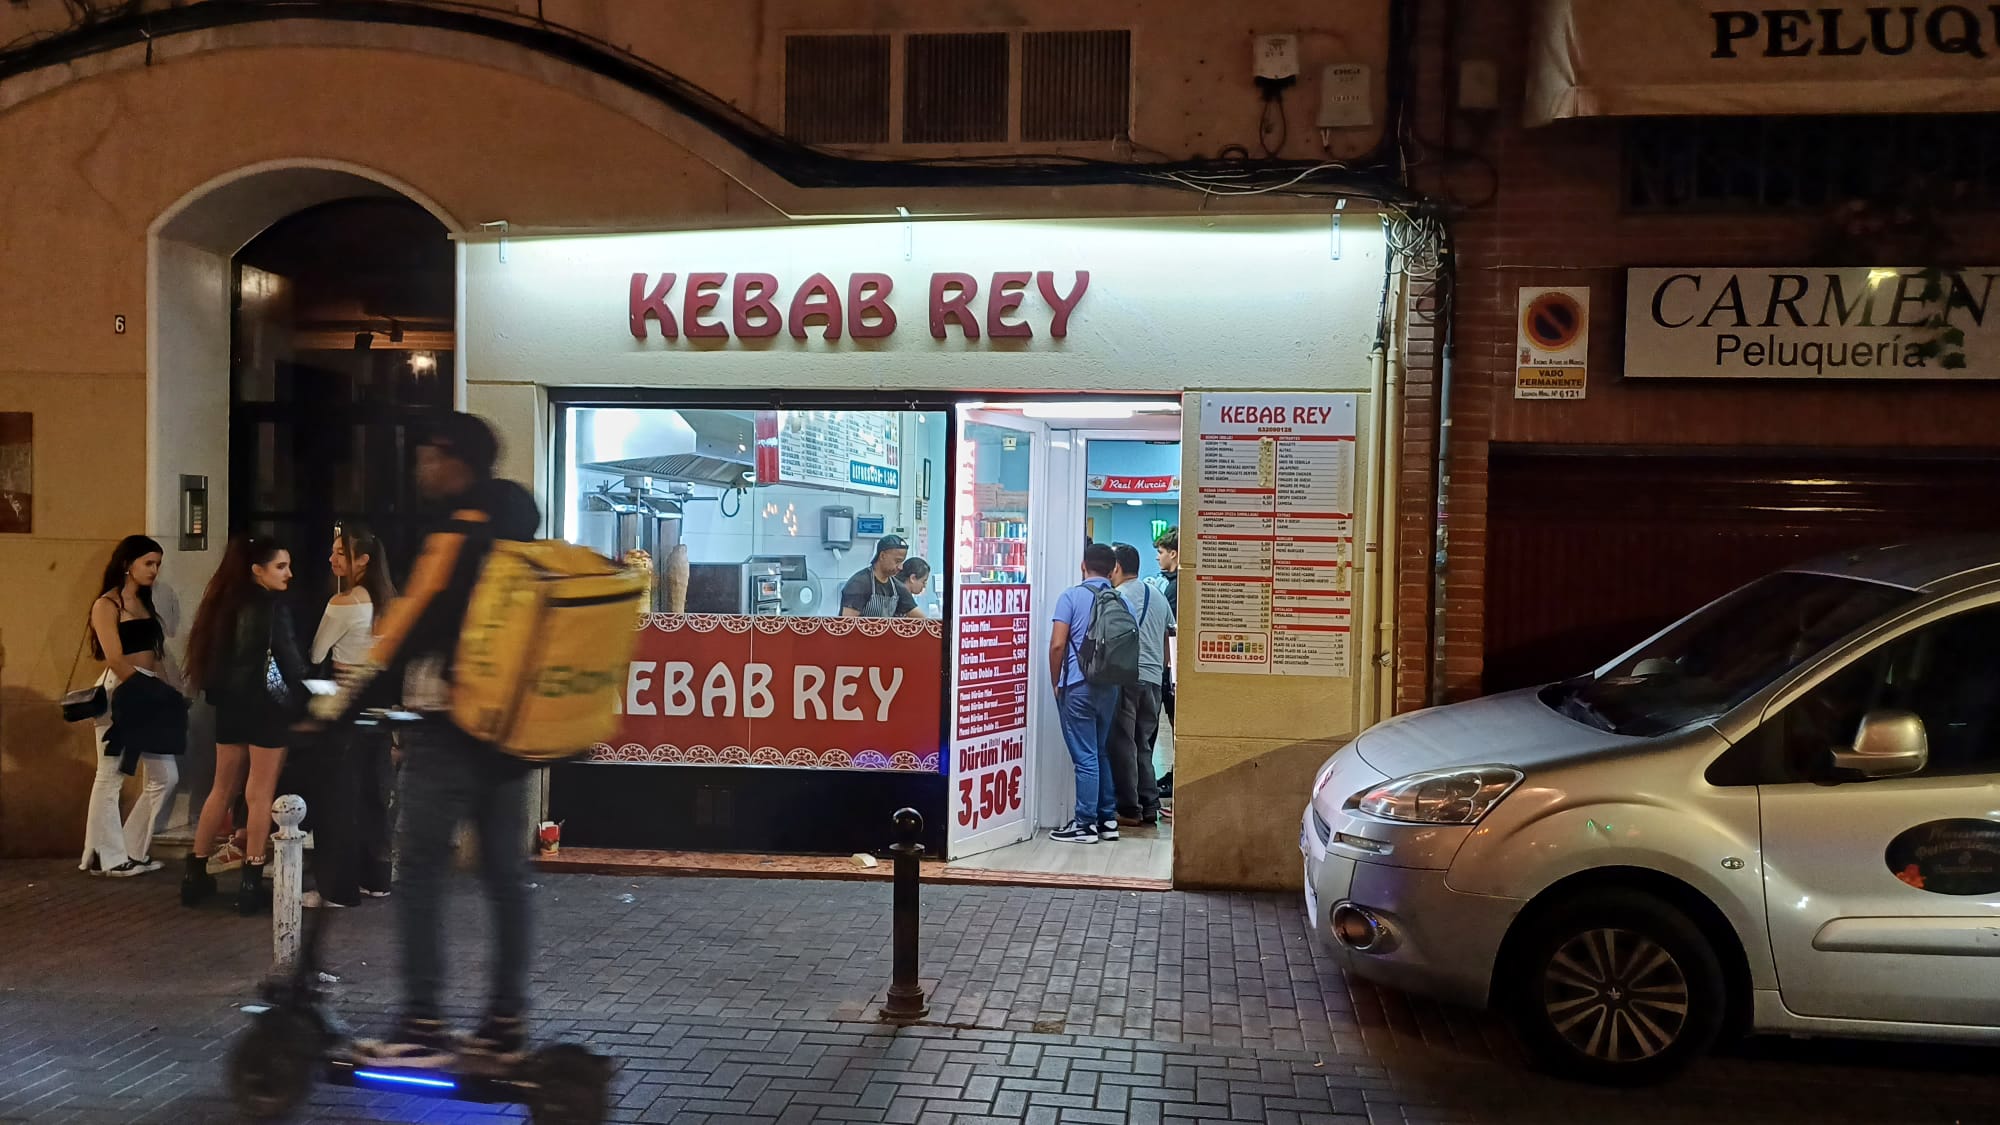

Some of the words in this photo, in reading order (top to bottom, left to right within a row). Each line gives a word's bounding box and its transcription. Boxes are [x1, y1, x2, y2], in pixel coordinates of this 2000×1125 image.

[1711, 5, 2000, 58] PELUQ
[629, 272, 898, 338] KEBAB
[929, 270, 1090, 338] REY
[1651, 273, 2000, 328] CARMEN
[115, 316, 125, 333] 6
[1715, 334, 1927, 374] Peluquería
[1519, 378, 1583, 386] PERMANENTE
[1220, 406, 1286, 424] KEBAB
[1292, 406, 1332, 424] REY
[1109, 479, 1131, 489] Real
[1134, 479, 1167, 489] Murcia
[962, 589, 1003, 615] KEBAB
[1005, 589, 1028, 613] REY
[613, 661, 774, 718] EBAB
[793, 665, 903, 721] REY
[960, 743, 998, 773] Dürüm
[1001, 735, 1023, 763] Mini
[958, 766, 1022, 830] 3,50€
